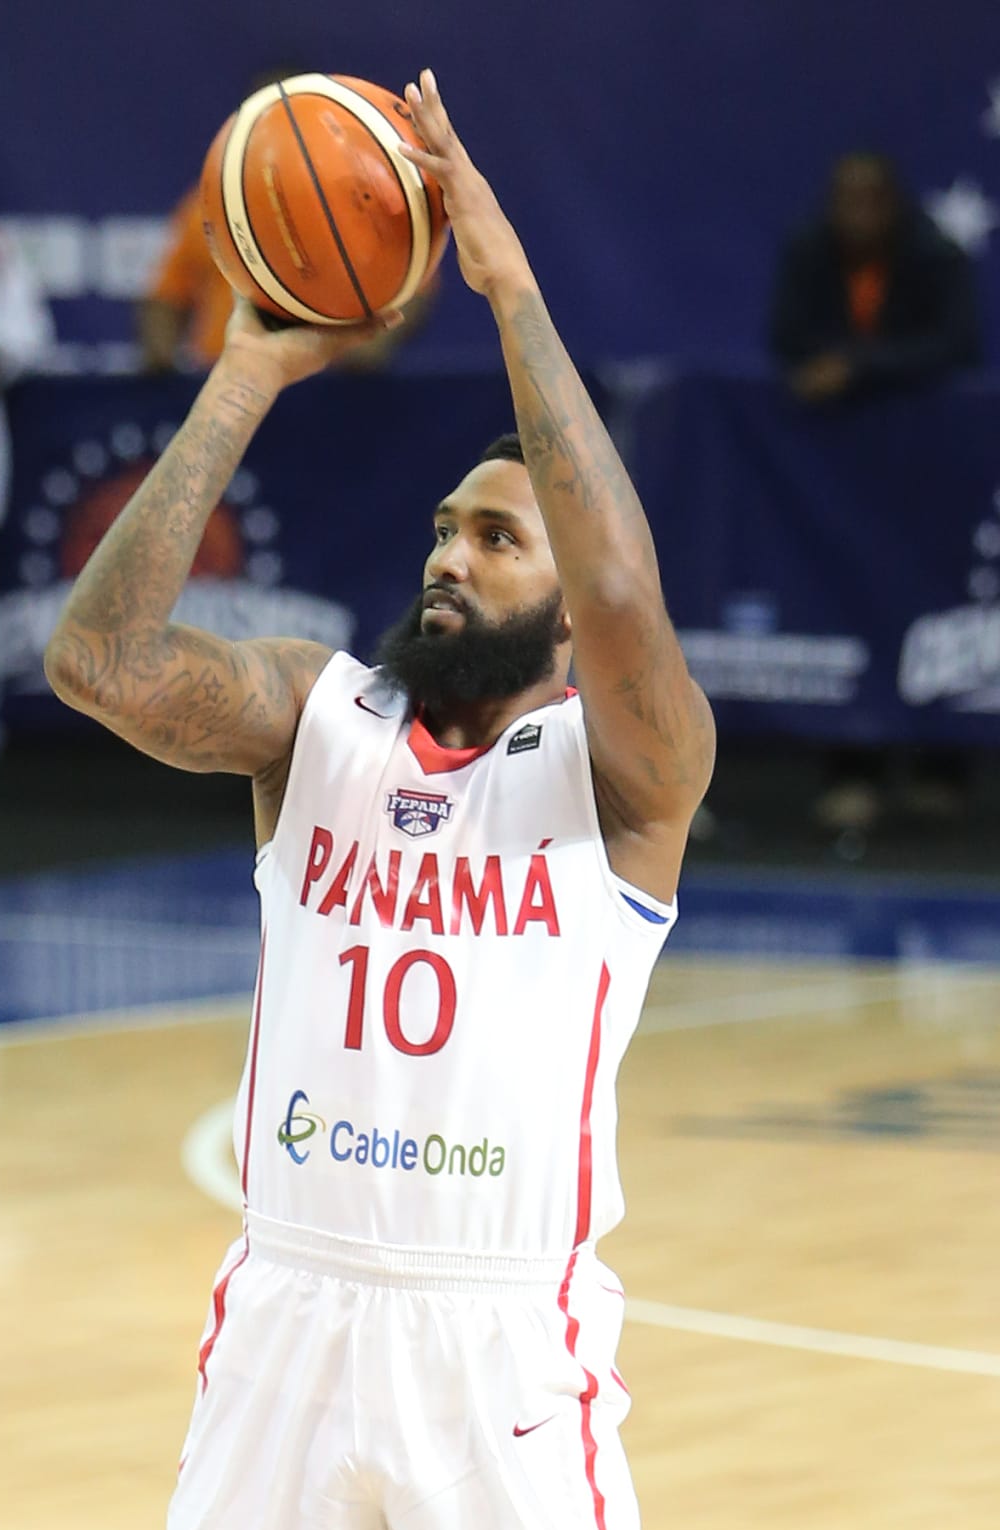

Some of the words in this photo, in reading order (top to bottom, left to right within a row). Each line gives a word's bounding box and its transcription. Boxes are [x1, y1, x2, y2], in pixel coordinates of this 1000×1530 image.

[390, 796, 448, 817] FEPABA
[298, 826, 561, 937] PANAMÁ
[338, 944, 457, 1057] 10
